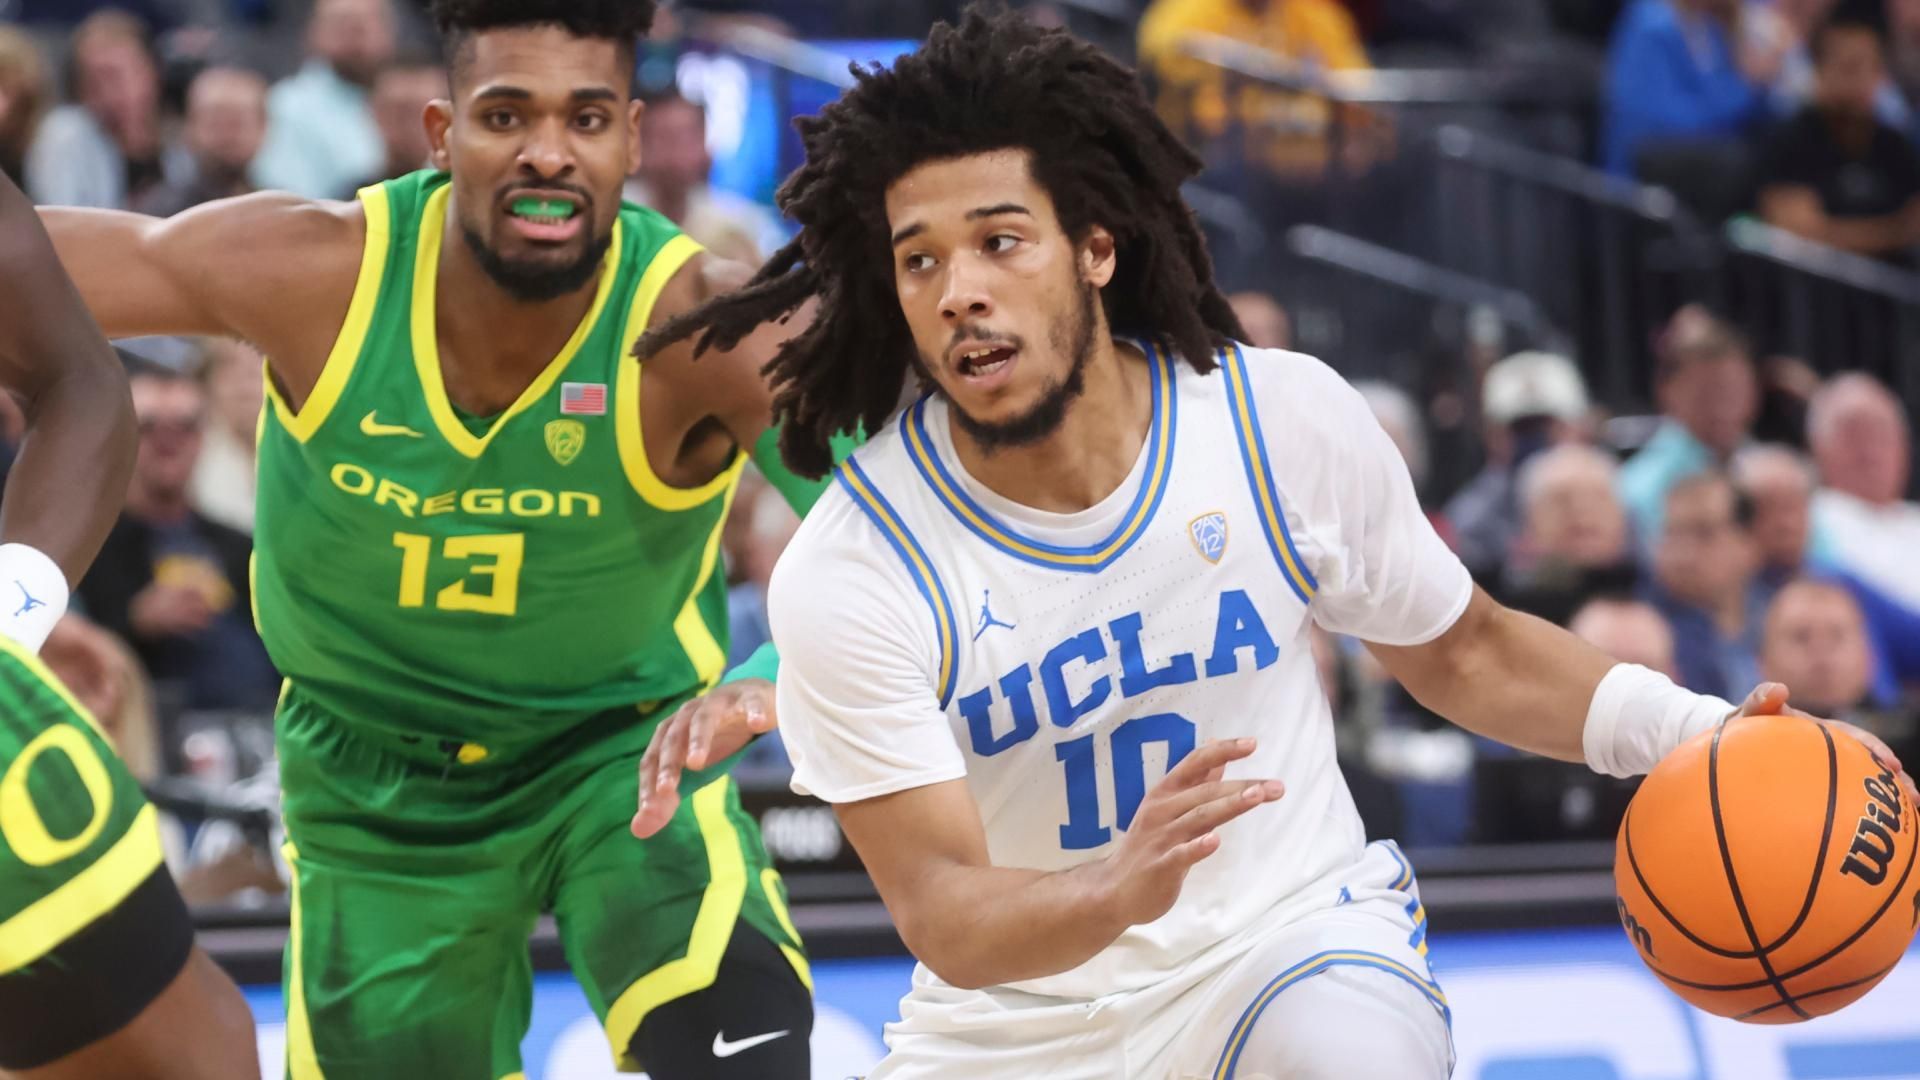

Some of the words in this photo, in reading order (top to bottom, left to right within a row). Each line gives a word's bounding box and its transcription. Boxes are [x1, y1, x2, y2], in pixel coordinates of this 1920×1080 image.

[330, 463, 601, 518] OREGON
[392, 531, 525, 616] 13
[1203, 533, 1222, 554] 12
[958, 589, 1280, 758] UCLA
[1054, 712, 1196, 850] 10
